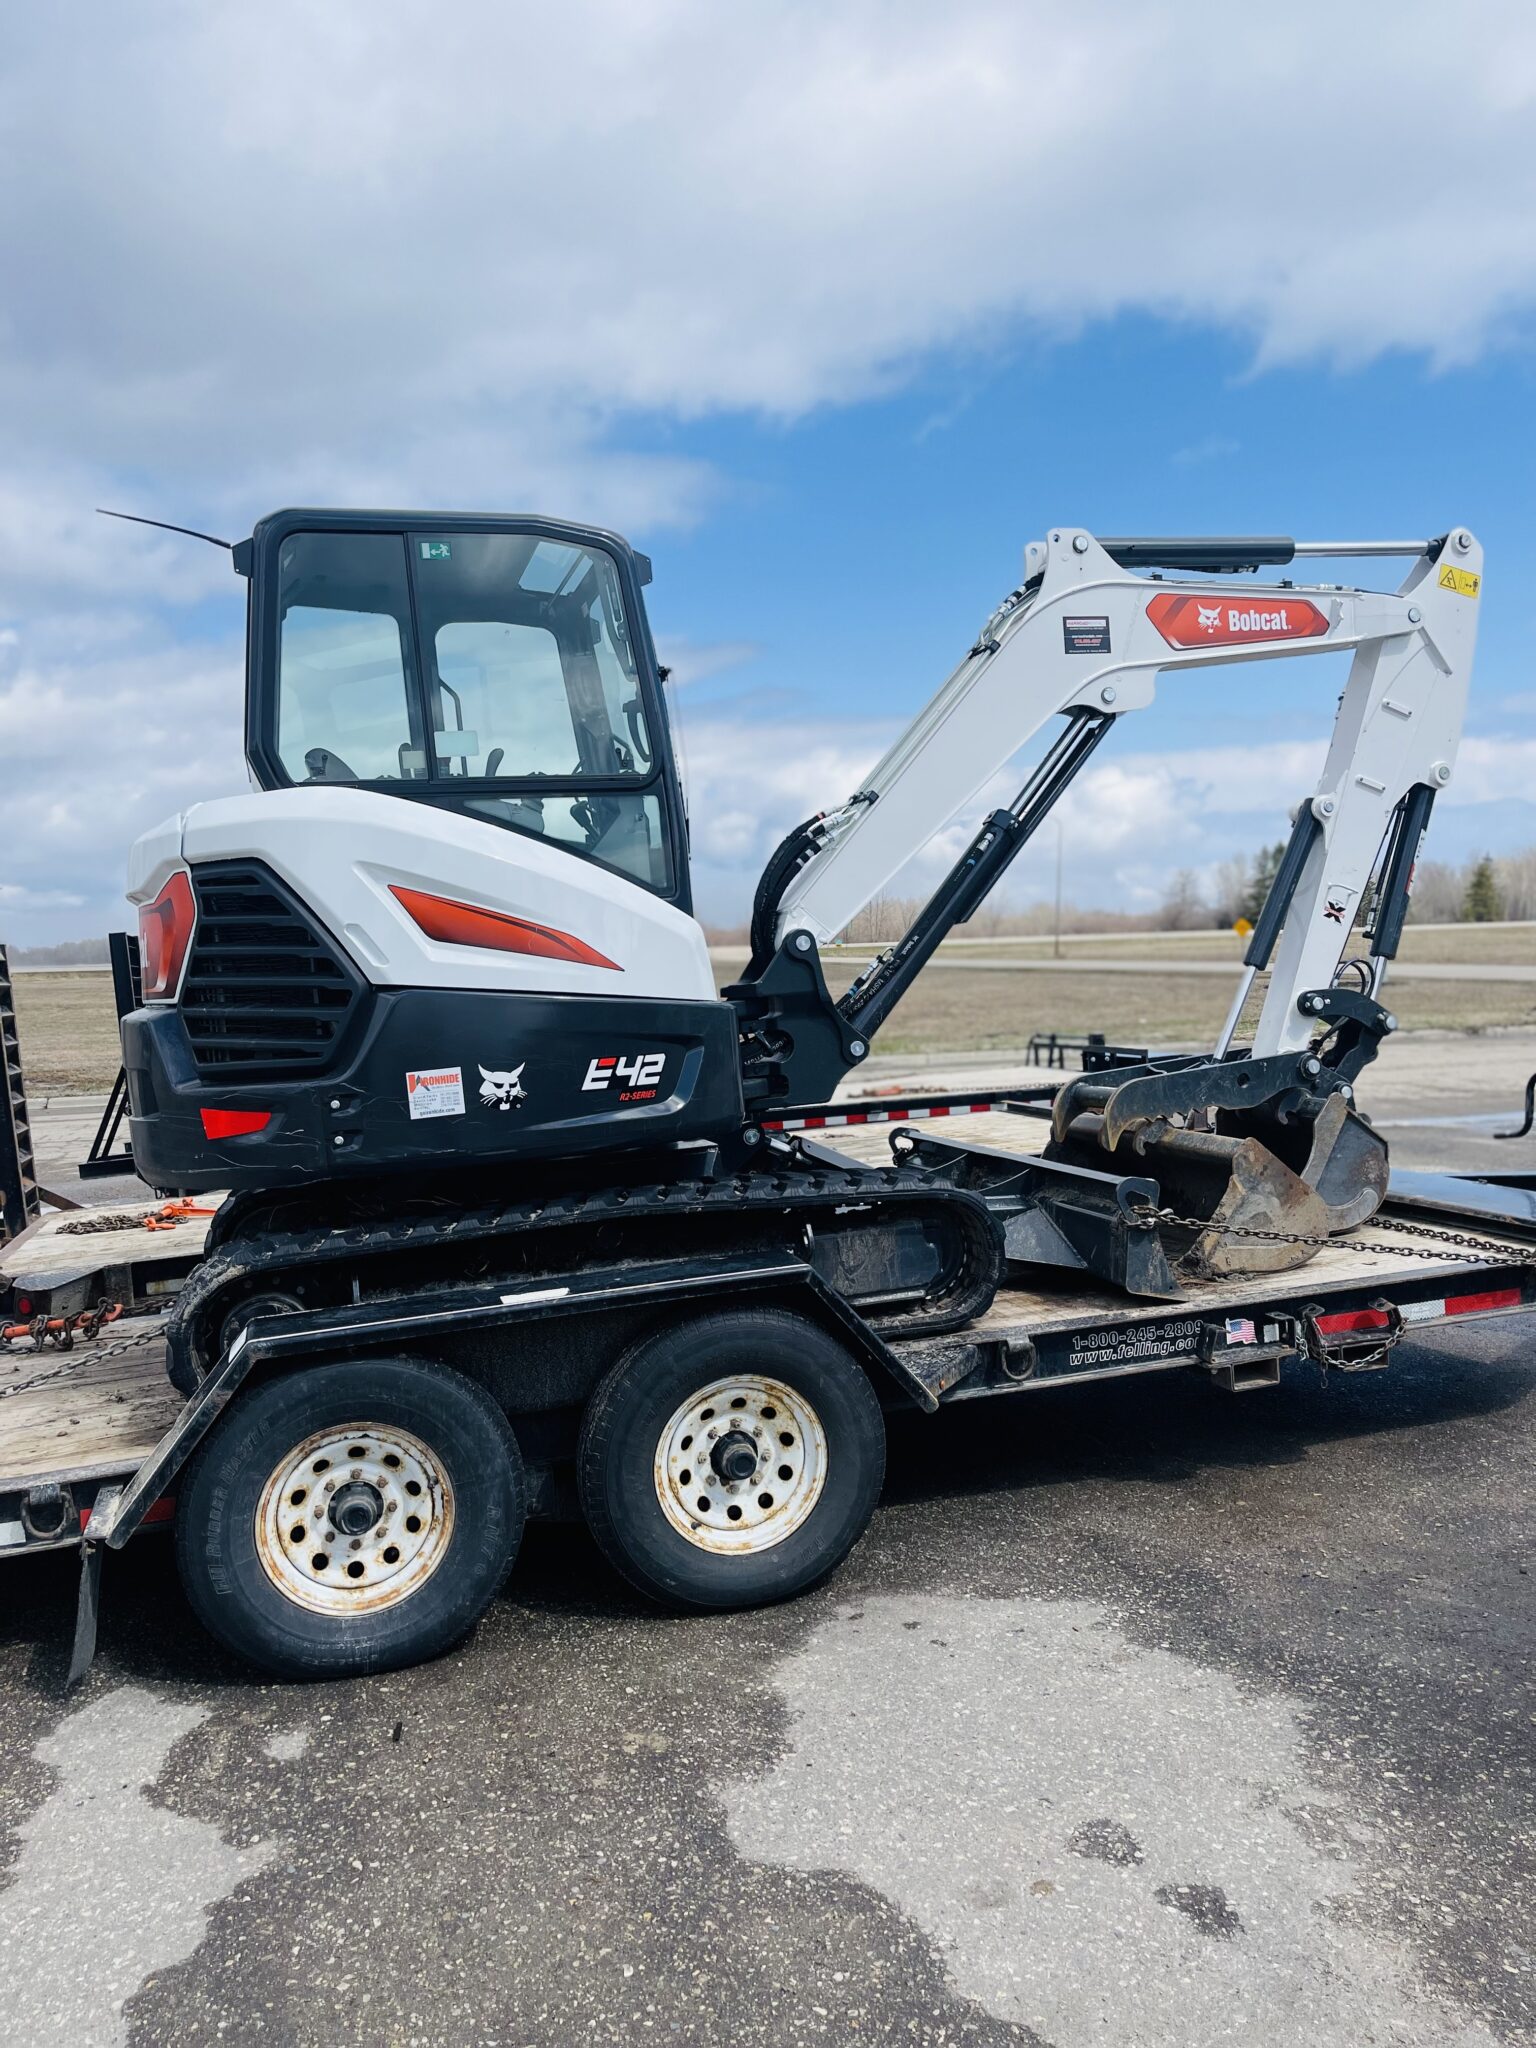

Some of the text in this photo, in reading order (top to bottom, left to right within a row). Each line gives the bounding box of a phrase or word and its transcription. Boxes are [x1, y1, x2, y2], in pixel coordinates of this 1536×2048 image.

[1227, 609, 1288, 632] Bobcat
[581, 1053, 666, 1091] E42
[619, 1090, 657, 1101] R2-SERIES
[1072, 1320, 1204, 1351] 1-800-245-2809
